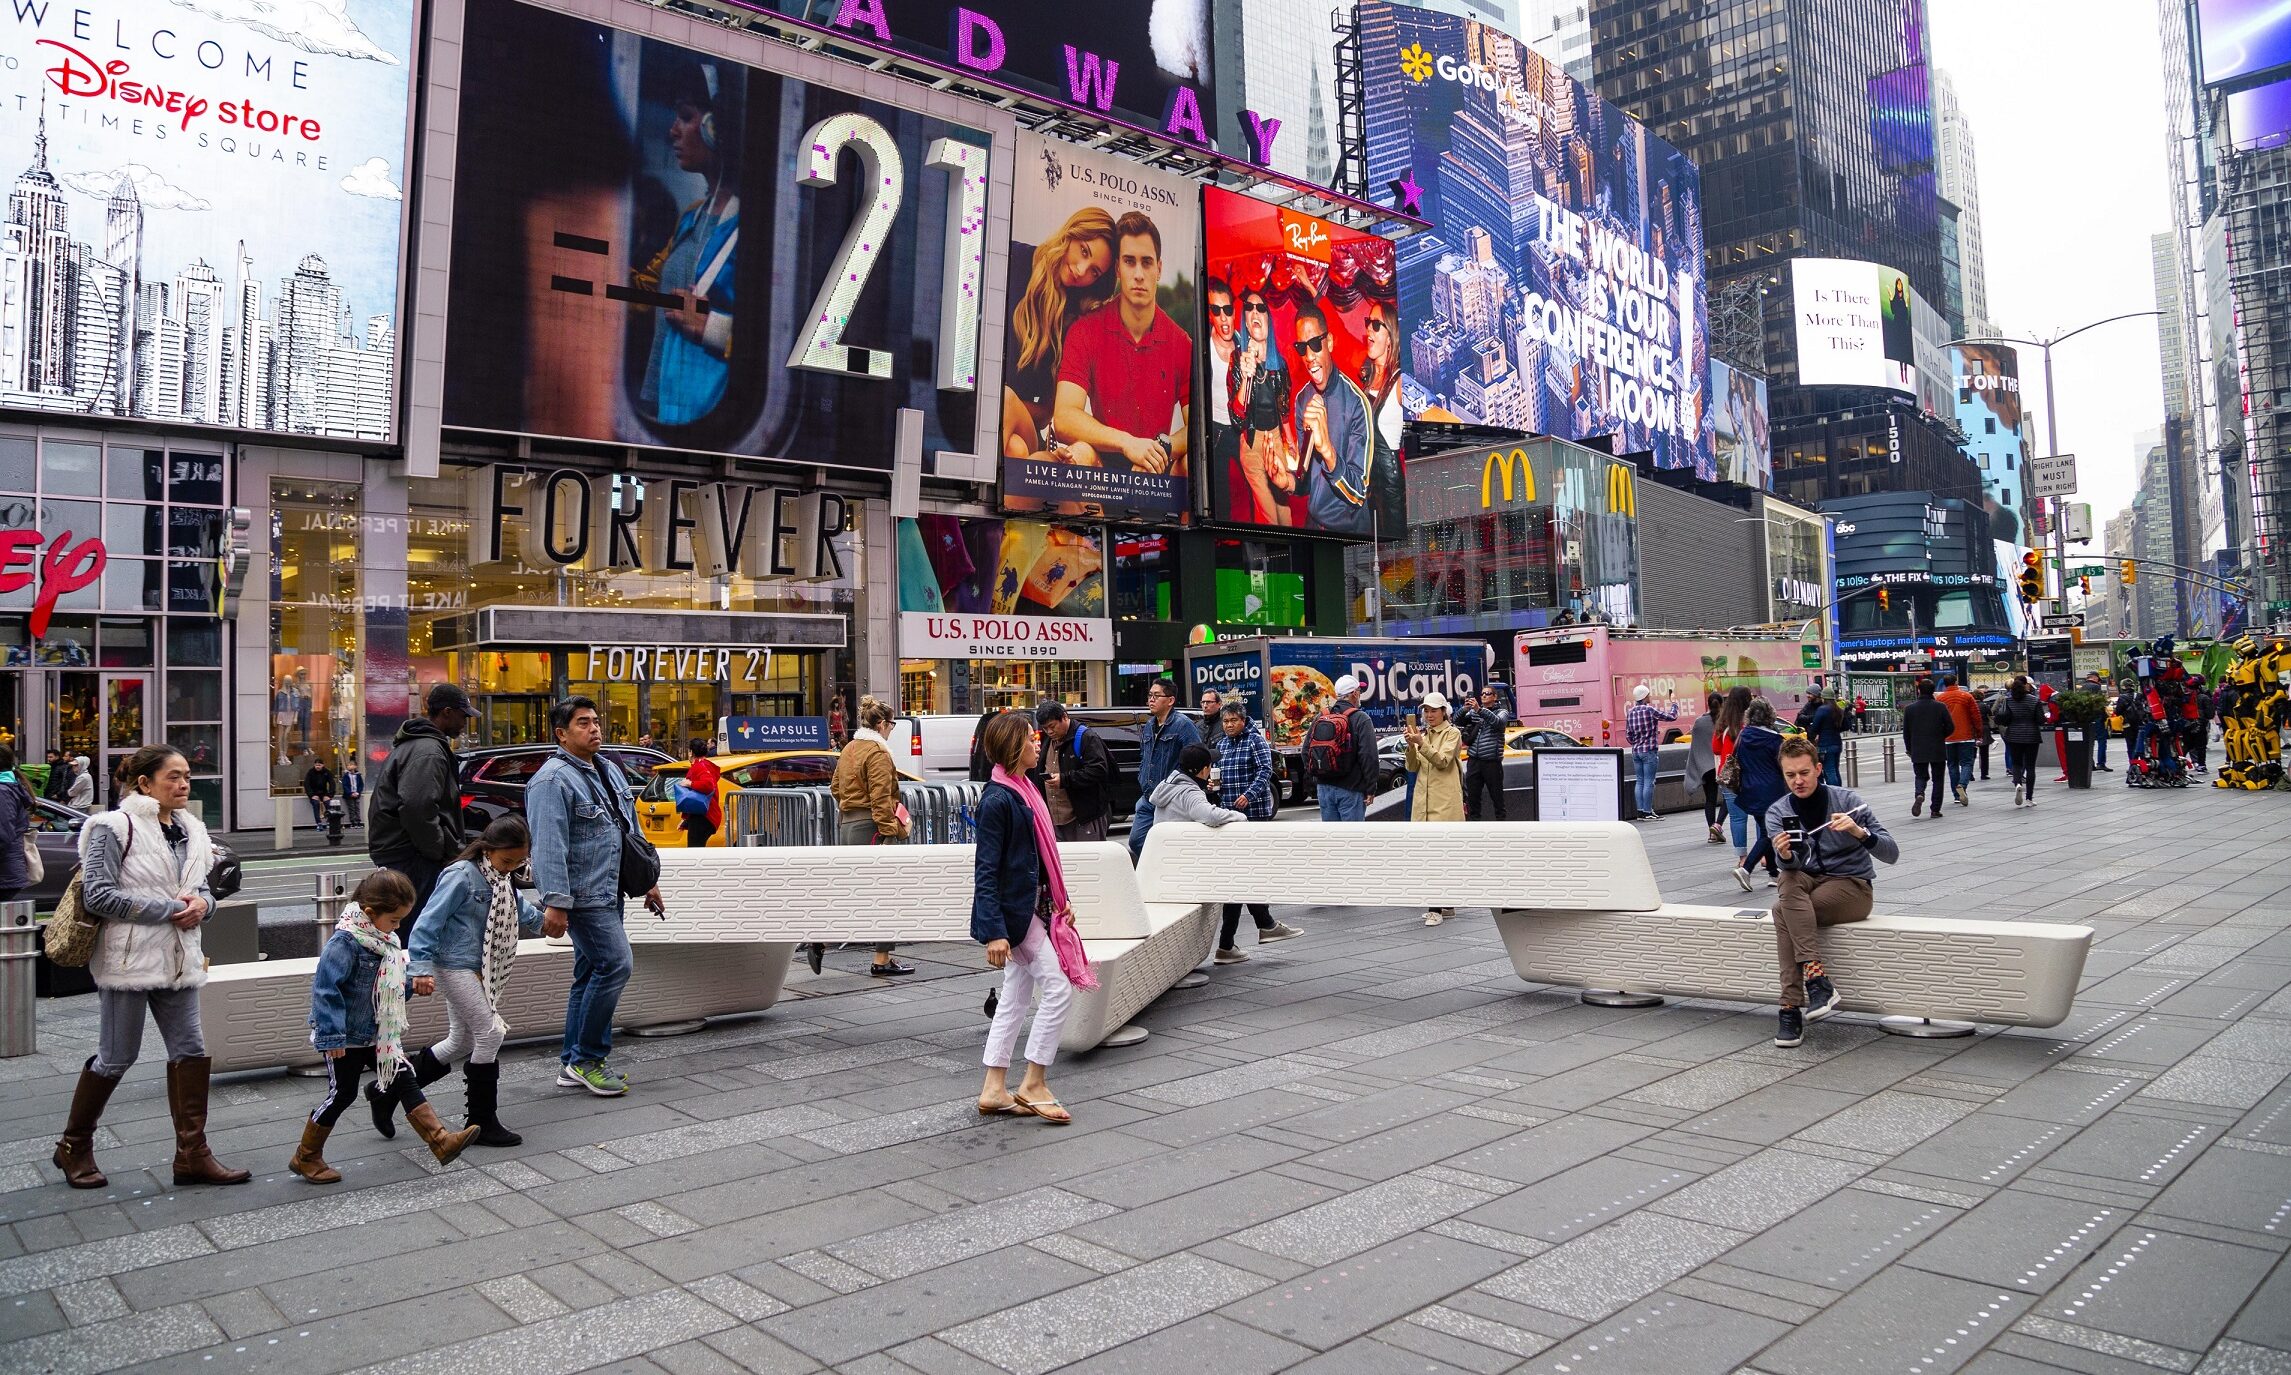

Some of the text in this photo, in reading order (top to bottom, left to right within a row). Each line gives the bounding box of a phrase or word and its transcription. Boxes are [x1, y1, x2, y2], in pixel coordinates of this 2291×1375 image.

[13, 0, 310, 91] WELCOME
[218, 101, 322, 141] store
[59, 103, 167, 140] TIMES
[198, 132, 330, 171] SQUARE
[1070, 163, 1179, 207] U.S. POLO ASSN.
[1093, 191, 1152, 212] SINCE 1890
[788, 113, 989, 391] 21
[1534, 190, 1669, 301] THE WORLD
[1588, 268, 1672, 347] IS YOUR
[1815, 289, 1870, 305] Is There
[1806, 313, 1880, 329] More Than
[1524, 292, 1674, 392] CONFERENCE
[1828, 336, 1865, 350] This?
[1974, 375, 1999, 390] ON
[2000, 376, 2019, 393] THE
[1610, 373, 1676, 437] ROOM
[1888, 414, 1901, 463] 1500
[2033, 459, 2074, 470] RIGHT LANE
[1026, 464, 1171, 489] LIVE AUTHENTICALLY
[2042, 471, 2067, 481] MUST
[1024, 478, 1049, 486] PAMELA
[1051, 480, 1083, 489] FLANAGAN
[1089, 484, 1109, 492] JONNY
[1110, 486, 1130, 494] LAVINE
[1150, 490, 1173, 499] PLAYERS
[2035, 482, 2076, 493] TURN RIGHT
[472, 462, 847, 581] FOREVER
[1836, 521, 1856, 534] abc
[1885, 574, 1906, 583] THE
[1908, 573, 1922, 582] FIX
[2086, 567, 2096, 576] 45
[1782, 577, 1821, 608] OD NAVY
[926, 617, 1093, 642] U.S. POLO ASSN.
[1955, 635, 1986, 644] Marriott
[969, 645, 1057, 656] SINCE 1890
[1865, 638, 1896, 647] laptop;
[587, 645, 773, 681] FOREVER 21
[1196, 660, 1261, 684] DiCarlo
[1408, 662, 1444, 671] FOOD SERVICE
[1351, 659, 1474, 702] DiCarlo
[1400, 705, 1416, 715] Food
[760, 725, 819, 736] CAPSULE
[1543, 720, 1554, 728] UP
